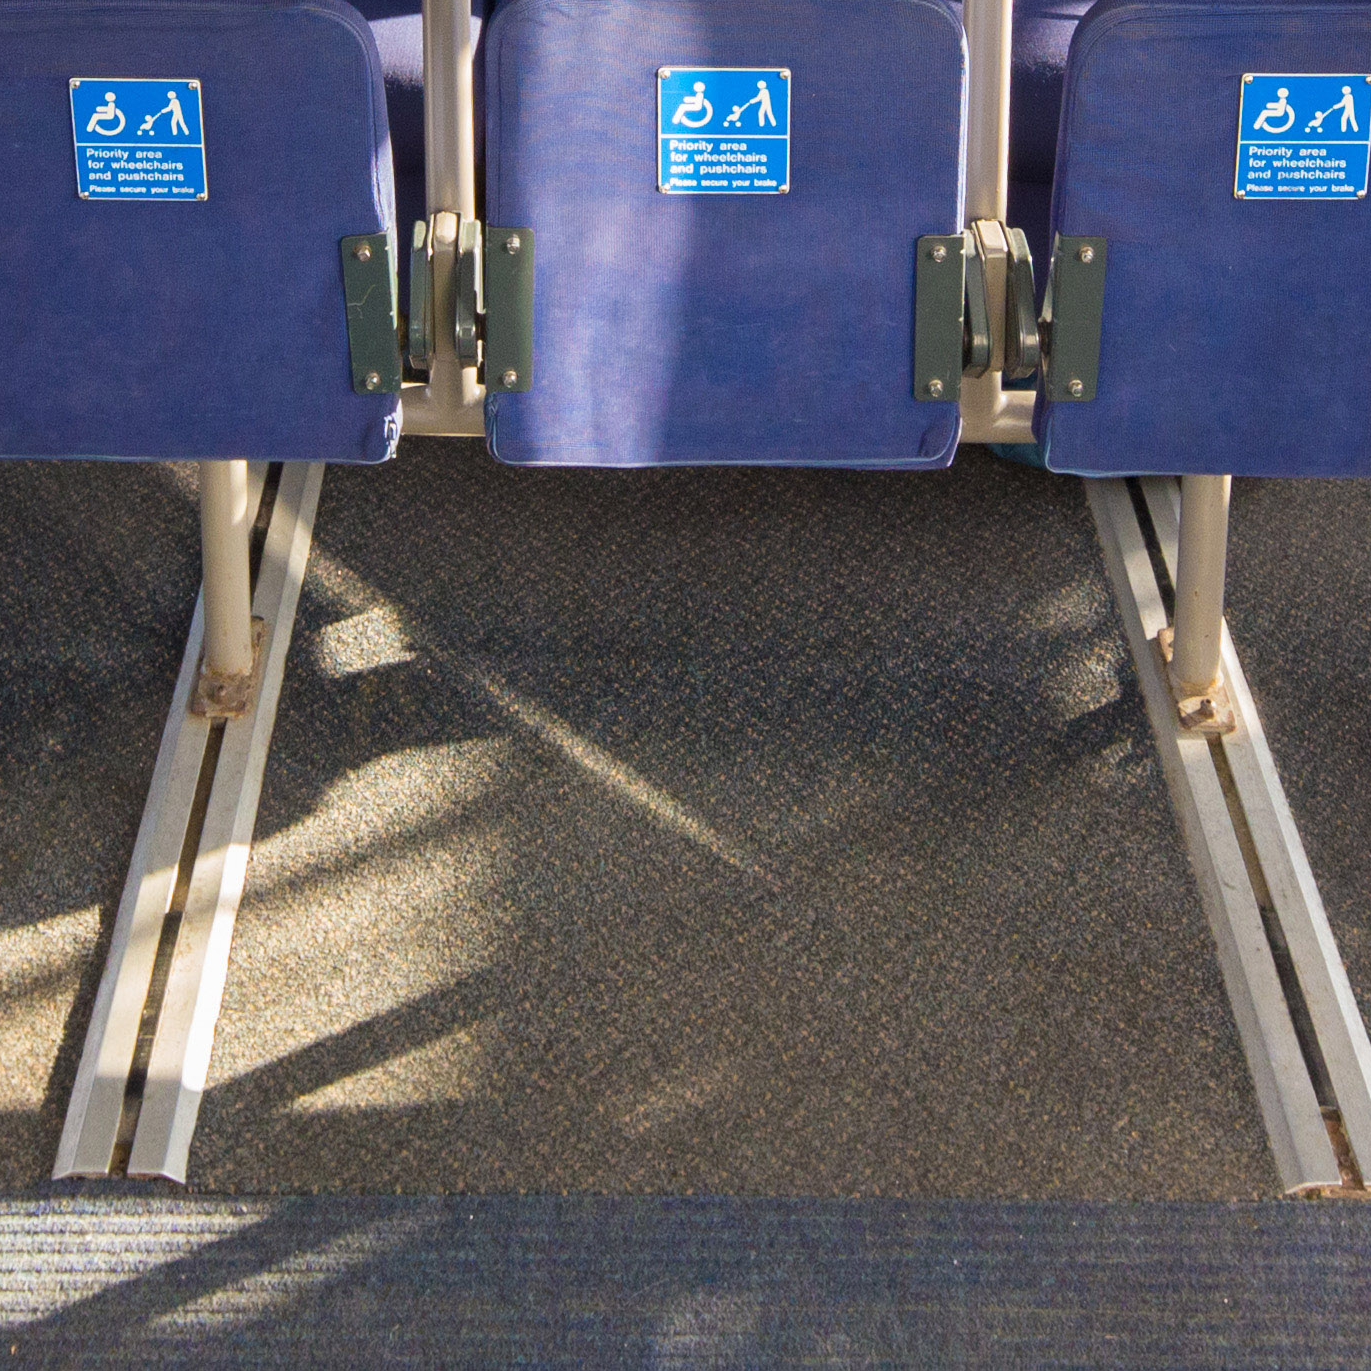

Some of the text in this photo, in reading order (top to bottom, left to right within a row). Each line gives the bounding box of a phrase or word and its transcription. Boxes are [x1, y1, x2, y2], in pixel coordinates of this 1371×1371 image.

[669, 140, 747, 152] Priority area
[86, 148, 162, 161] Priority area
[670, 152, 767, 162] for wheelchairs
[1249, 146, 1327, 158] Priority area
[88, 160, 183, 170] for wheelchairs
[1249, 158, 1346, 168] for wheelchairs
[670, 164, 767, 175] and pushchairs
[89, 171, 184, 183] and pushchairs
[1247, 169, 1345, 181] and pushchairs
[670, 178, 697, 187] Please
[732, 180, 750, 188] your
[754, 179, 777, 187] brake
[89, 185, 194, 195] Please secure your brake
[1246, 184, 1355, 193] Please secure your brake
